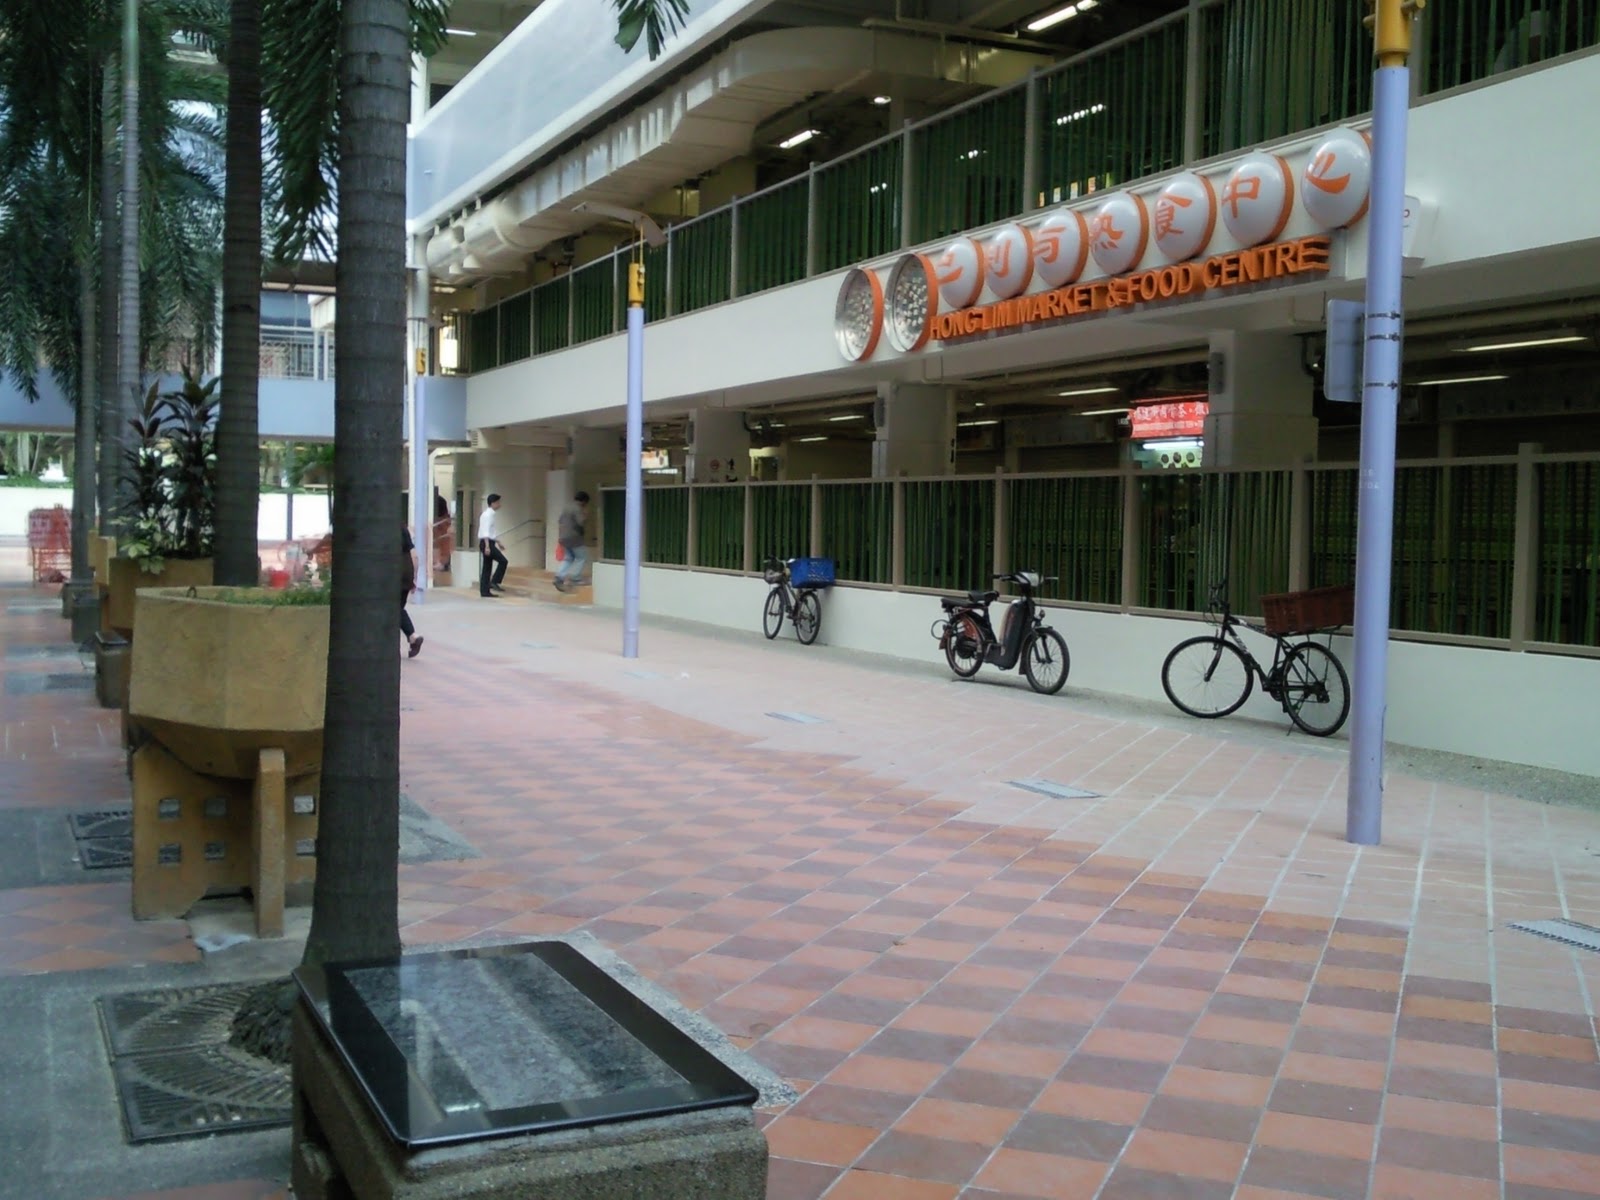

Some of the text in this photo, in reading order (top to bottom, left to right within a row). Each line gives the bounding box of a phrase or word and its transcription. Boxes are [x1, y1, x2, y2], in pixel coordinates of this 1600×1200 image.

[929, 236, 1330, 341] HONG LIM MARKET & FOOD CENTRE
